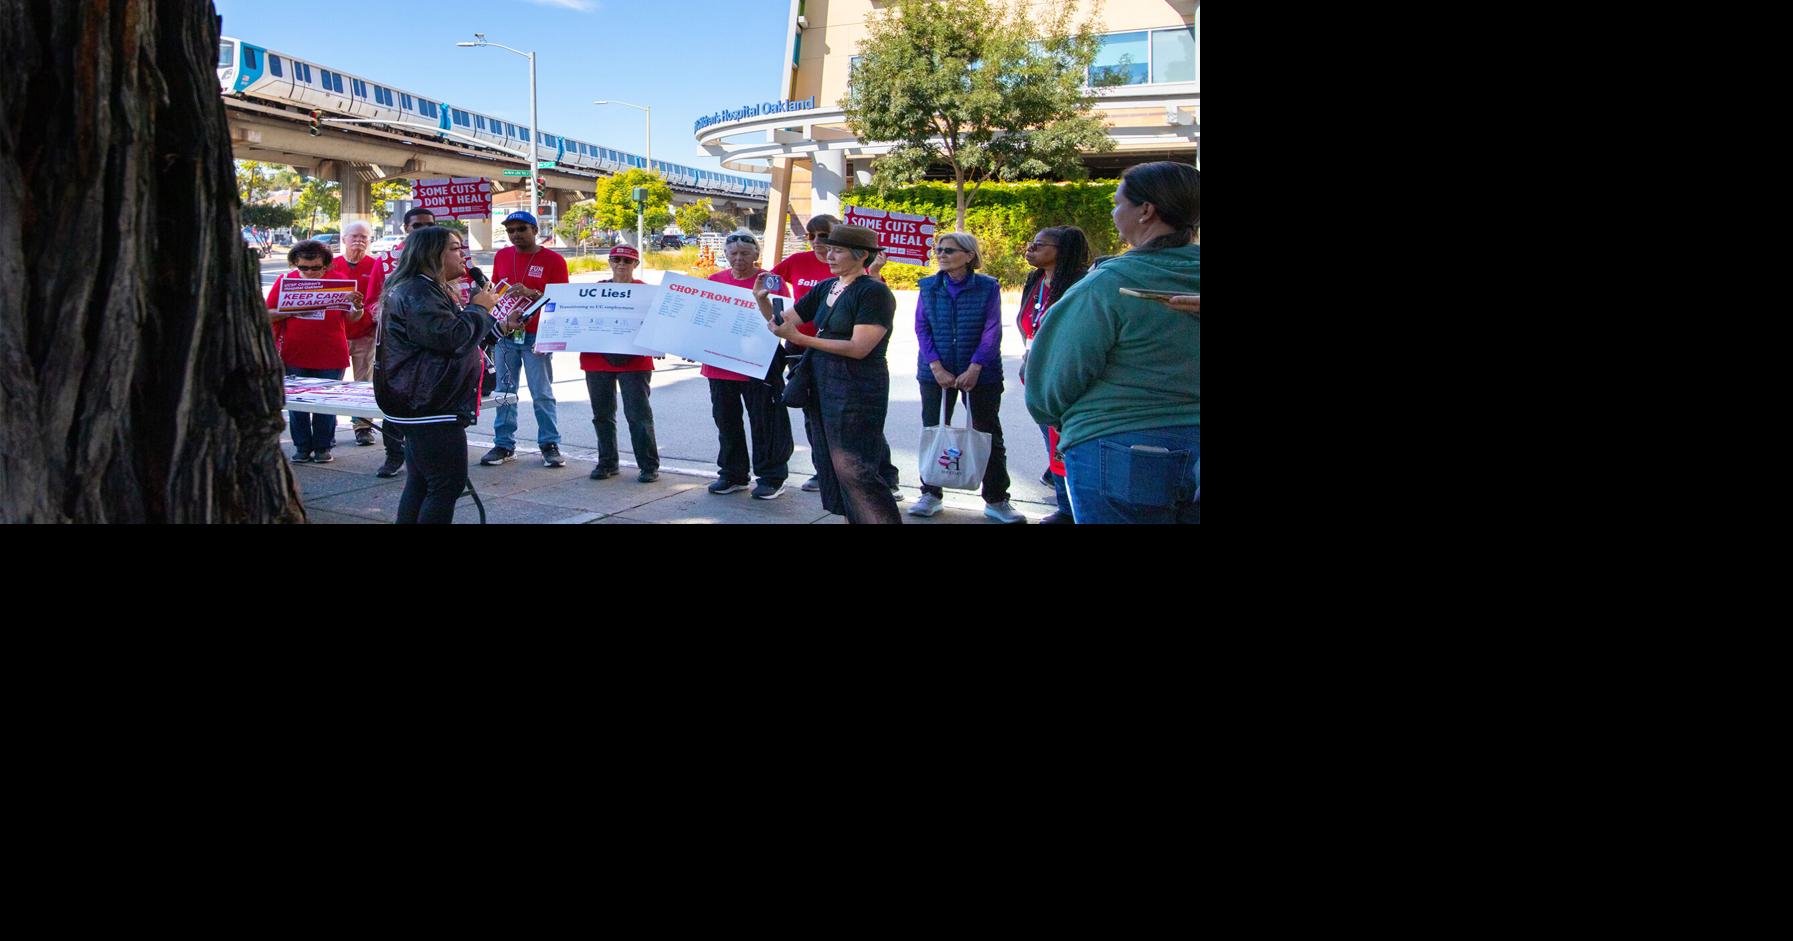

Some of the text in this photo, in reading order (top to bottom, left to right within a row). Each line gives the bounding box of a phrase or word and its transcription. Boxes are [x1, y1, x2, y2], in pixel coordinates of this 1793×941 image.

[722, 104, 760, 122] Hospital
[762, 95, 815, 115] Oakland
[420, 184, 476, 197] SOME CUTS
[424, 194, 484, 207] DON'T HEAL
[851, 216, 916, 233] SOME CUTS
[890, 233, 923, 246] HEAL
[579, 288, 632, 299] UC Lies!
[669, 283, 756, 310] CHOP FROM THE
